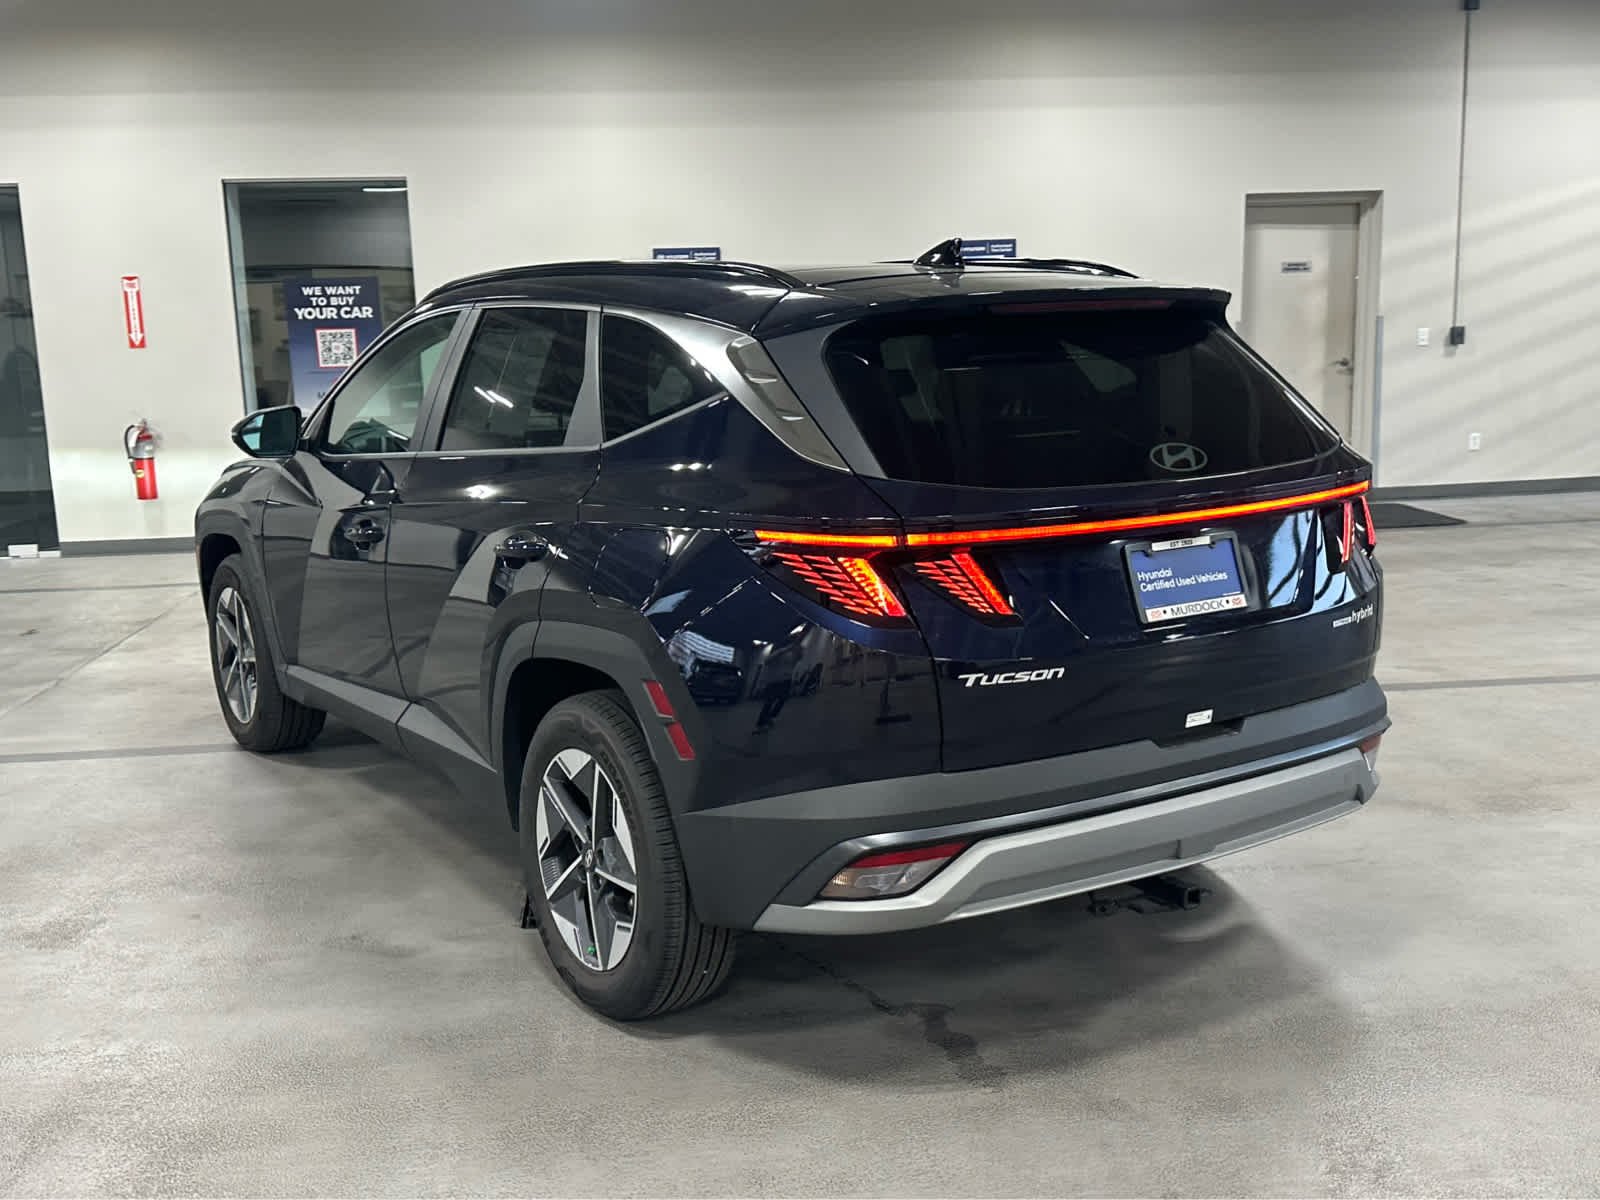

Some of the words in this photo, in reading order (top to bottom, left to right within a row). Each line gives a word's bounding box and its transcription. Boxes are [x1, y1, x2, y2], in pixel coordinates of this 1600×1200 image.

[301, 286, 322, 296] WE
[324, 285, 361, 295] WANT
[310, 297, 327, 306] TO
[329, 296, 355, 305] BUY
[294, 307, 338, 319] YOUR
[340, 306, 374, 318] CAR
[1137, 567, 1172, 581] Hyundai
[1140, 578, 1175, 592] Certified
[1175, 575, 1197, 587] Used
[1196, 571, 1228, 583] Vehicles
[1170, 600, 1225, 616] MURDOCK
[1351, 603, 1373, 623] hybrid
